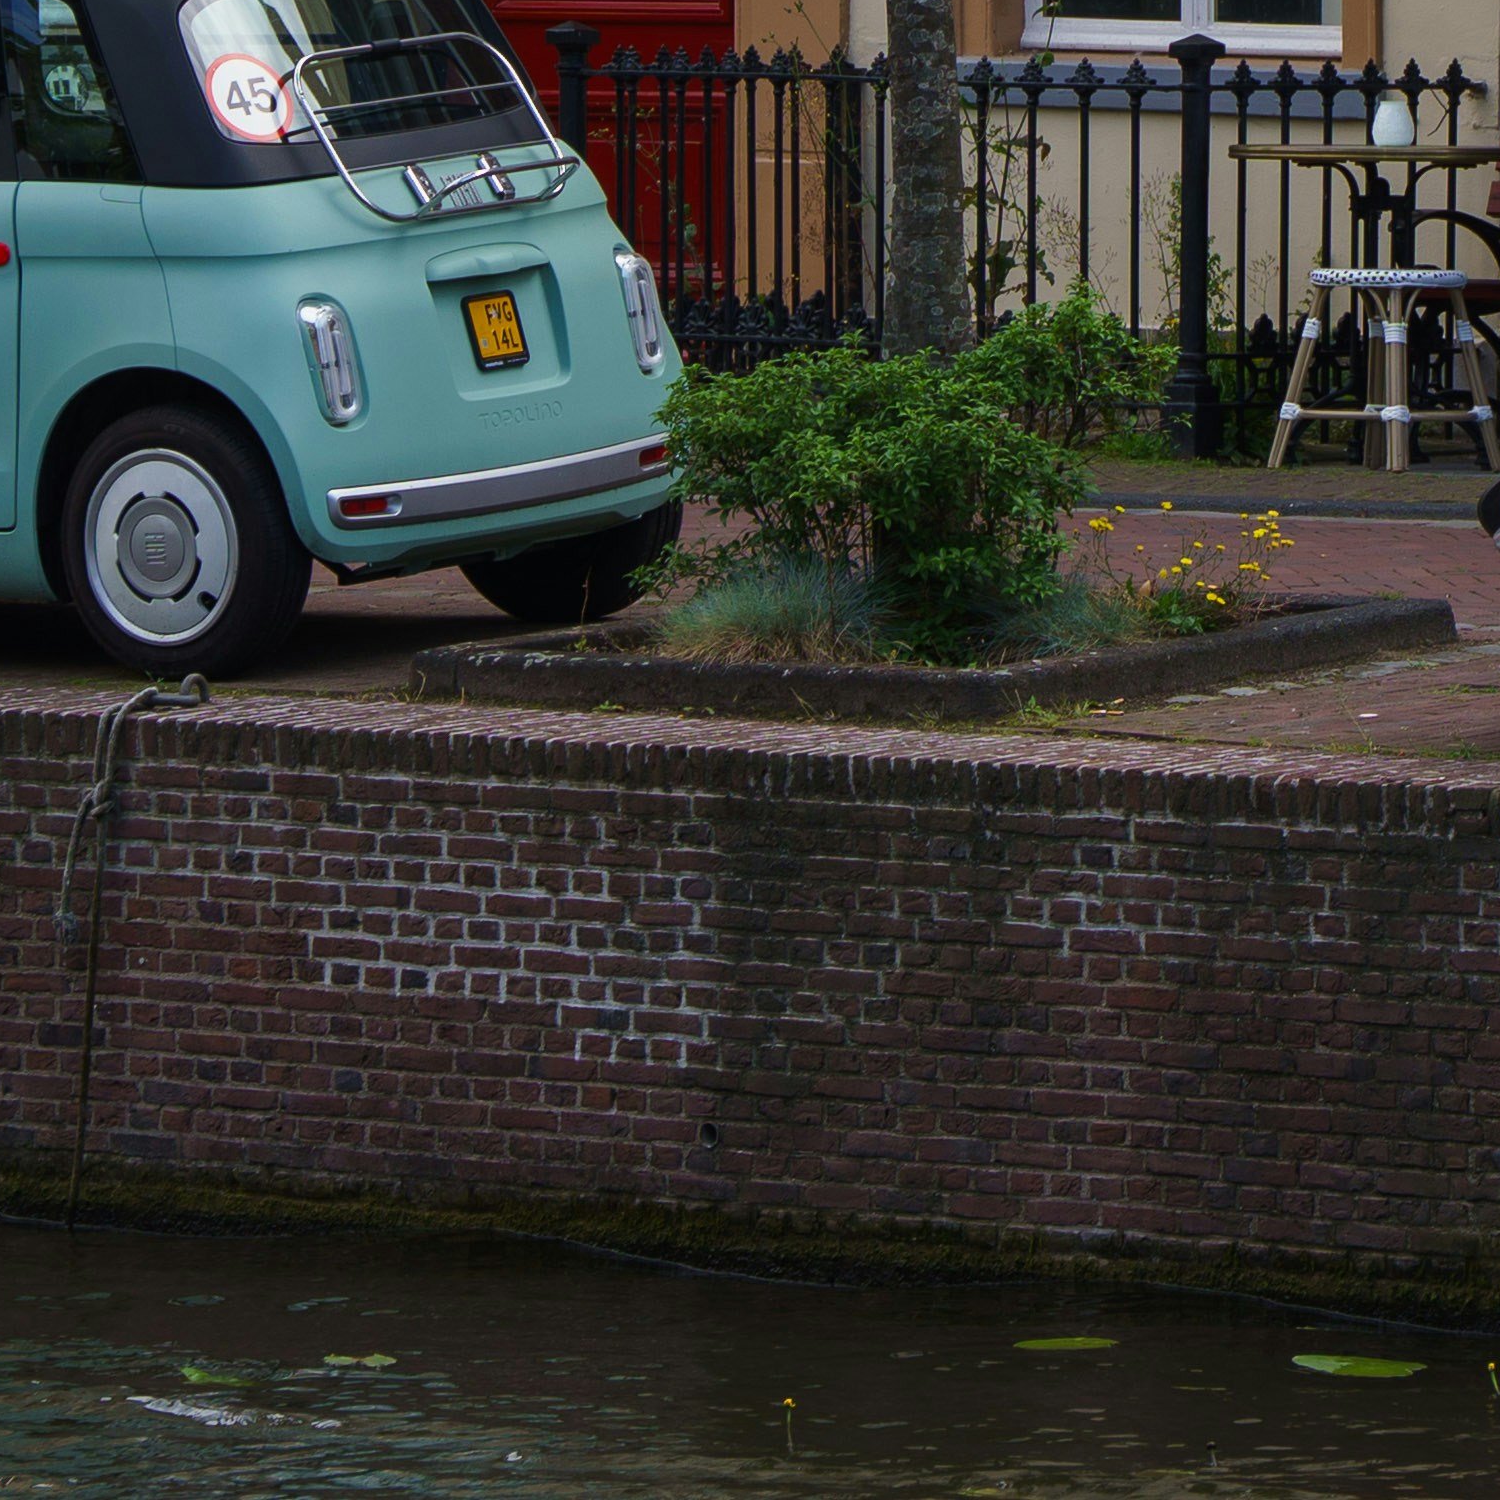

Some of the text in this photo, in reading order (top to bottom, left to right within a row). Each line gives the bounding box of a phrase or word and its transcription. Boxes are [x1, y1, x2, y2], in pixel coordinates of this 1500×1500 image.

[226, 77, 278, 116] 45
[484, 301, 513, 325] FVG
[491, 327, 520, 351] 14L
